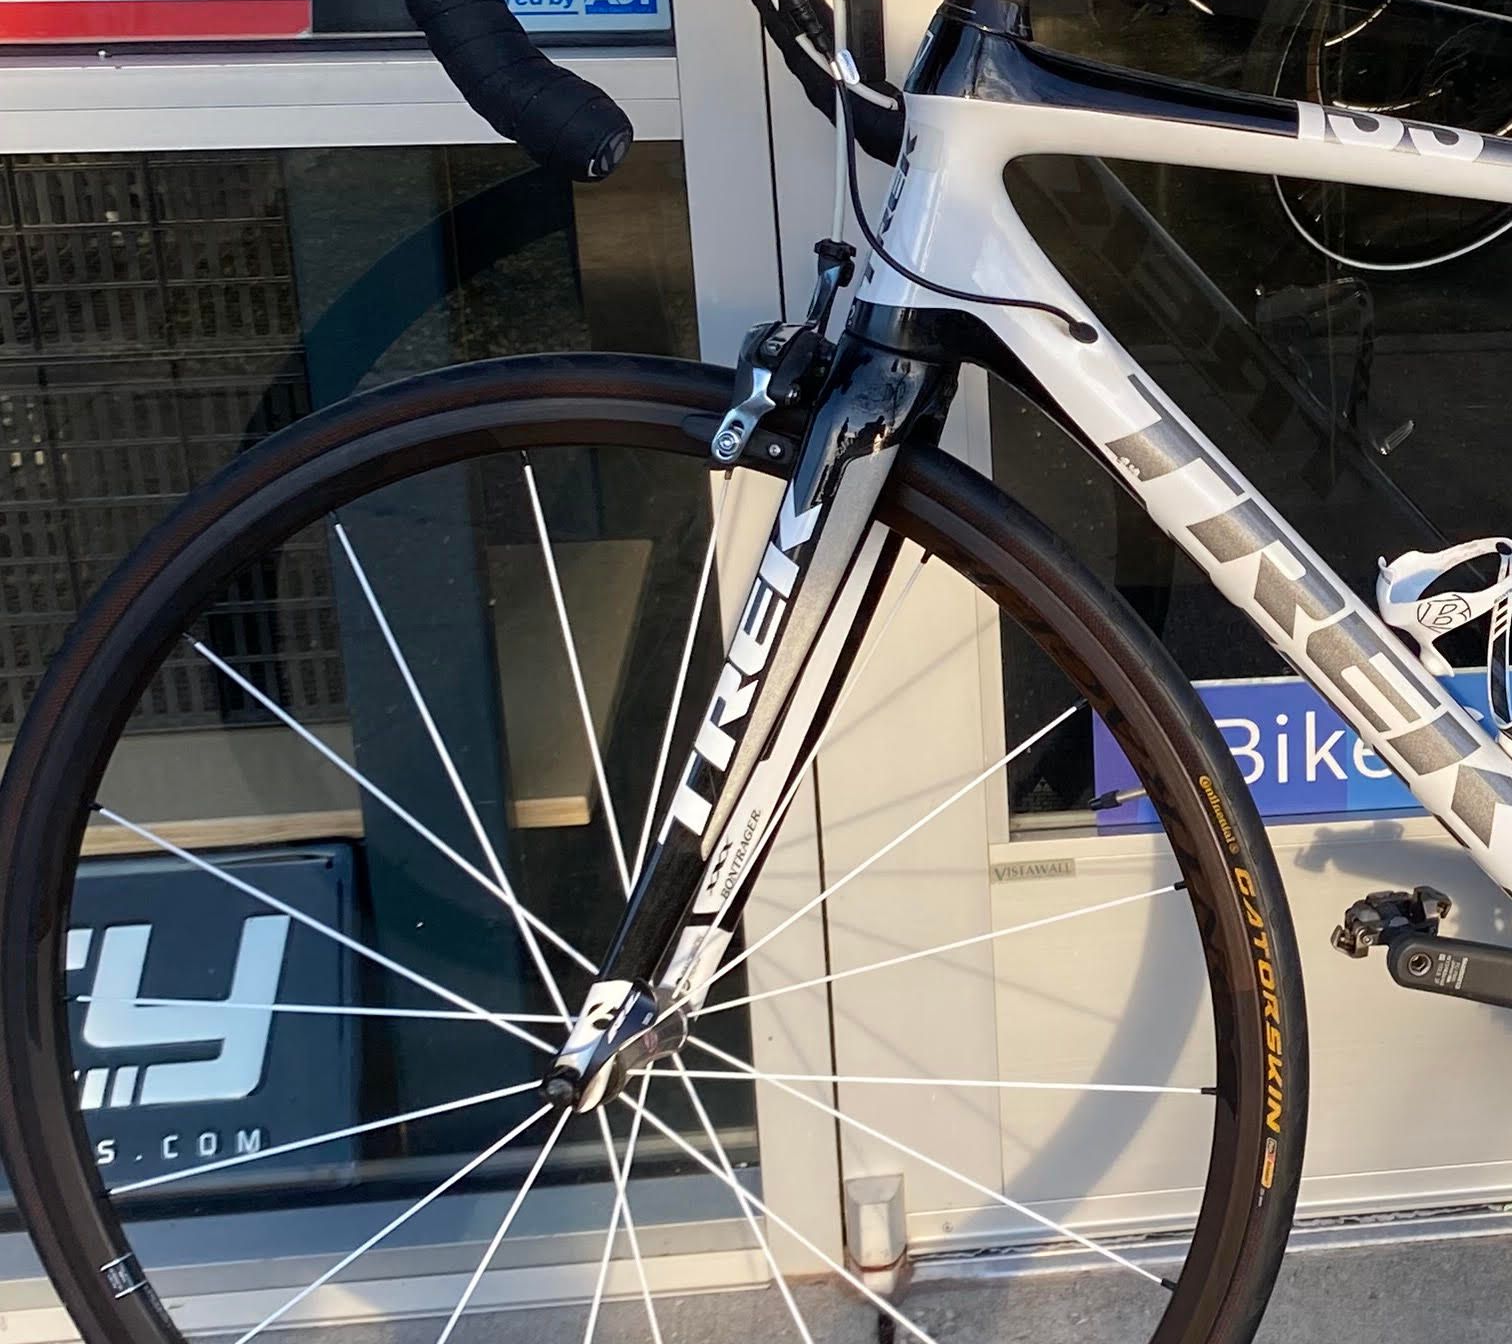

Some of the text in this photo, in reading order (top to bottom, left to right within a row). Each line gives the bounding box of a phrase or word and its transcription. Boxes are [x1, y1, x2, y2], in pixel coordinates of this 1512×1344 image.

[658, 477, 823, 846] TREK
[1213, 710, 1393, 784] Bike
[1199, 774, 1237, 845] Continental
[720, 808, 762, 901] BONTRAGER
[993, 861, 1073, 881] VISTAWALL
[1232, 866, 1282, 1134] GATORSKIN
